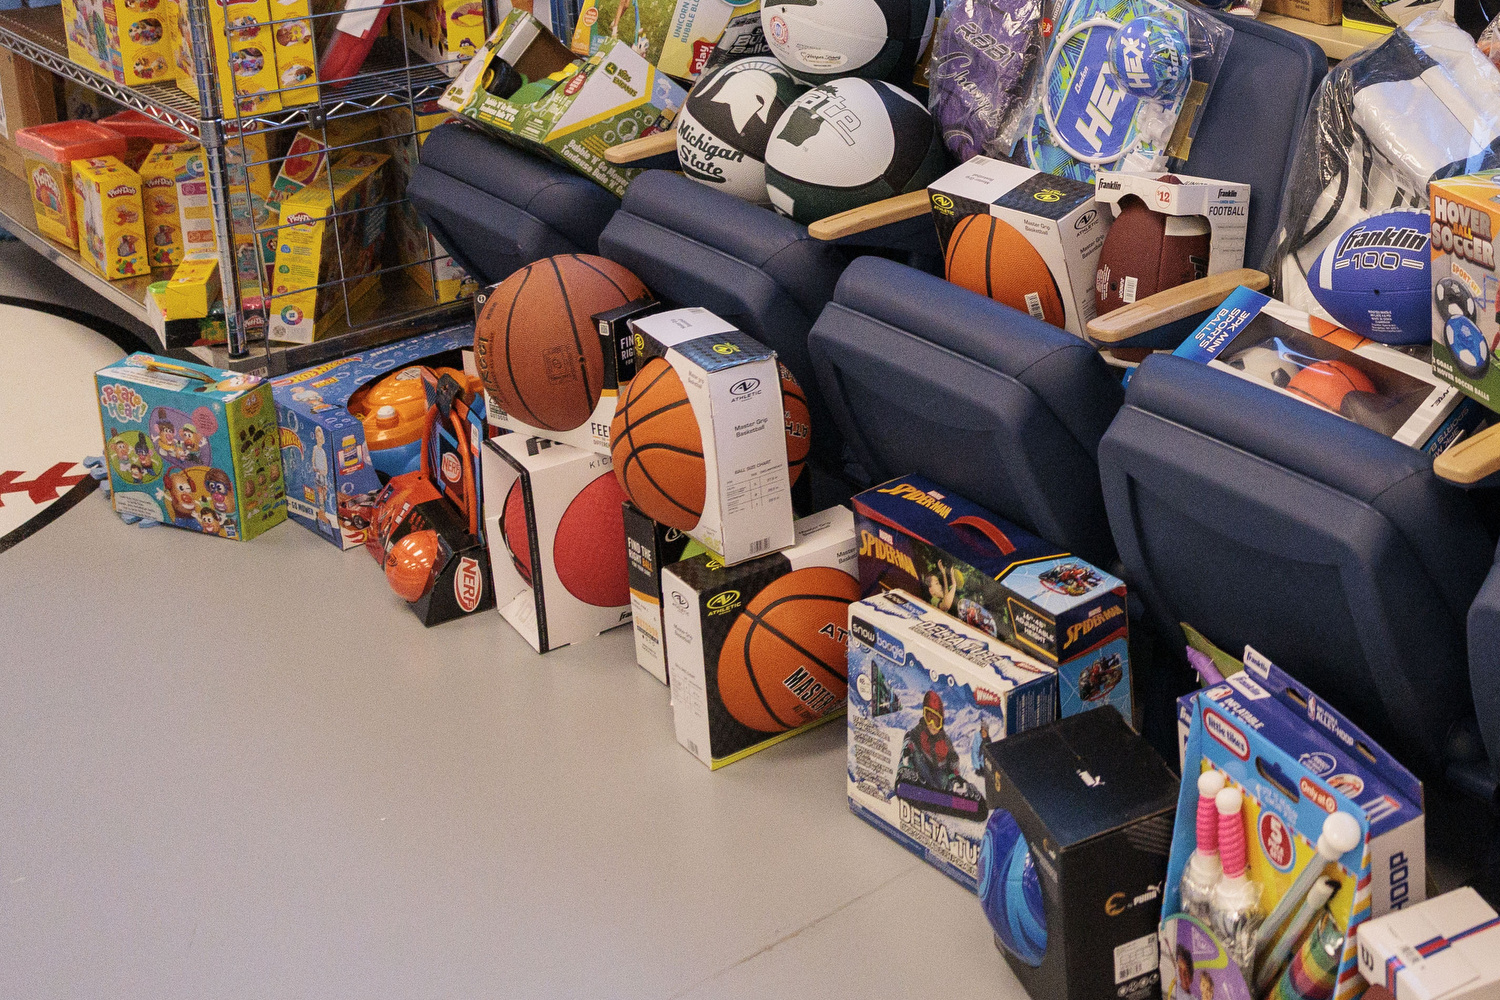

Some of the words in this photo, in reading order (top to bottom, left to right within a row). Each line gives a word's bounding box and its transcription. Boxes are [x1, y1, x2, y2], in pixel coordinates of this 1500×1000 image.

[673, 3, 689, 38] UNICORN
[680, 12, 696, 43] BUBBLE
[679, 118, 745, 163] Michigan
[680, 144, 723, 176] State
[1208, 205, 1245, 217] FOOTBALL
[1435, 196, 1492, 237] HOVER
[1338, 225, 1430, 259] Franklin
[1431, 222, 1496, 270] SOCCER
[460, 558, 482, 610] NERF
[852, 622, 876, 643] snow
